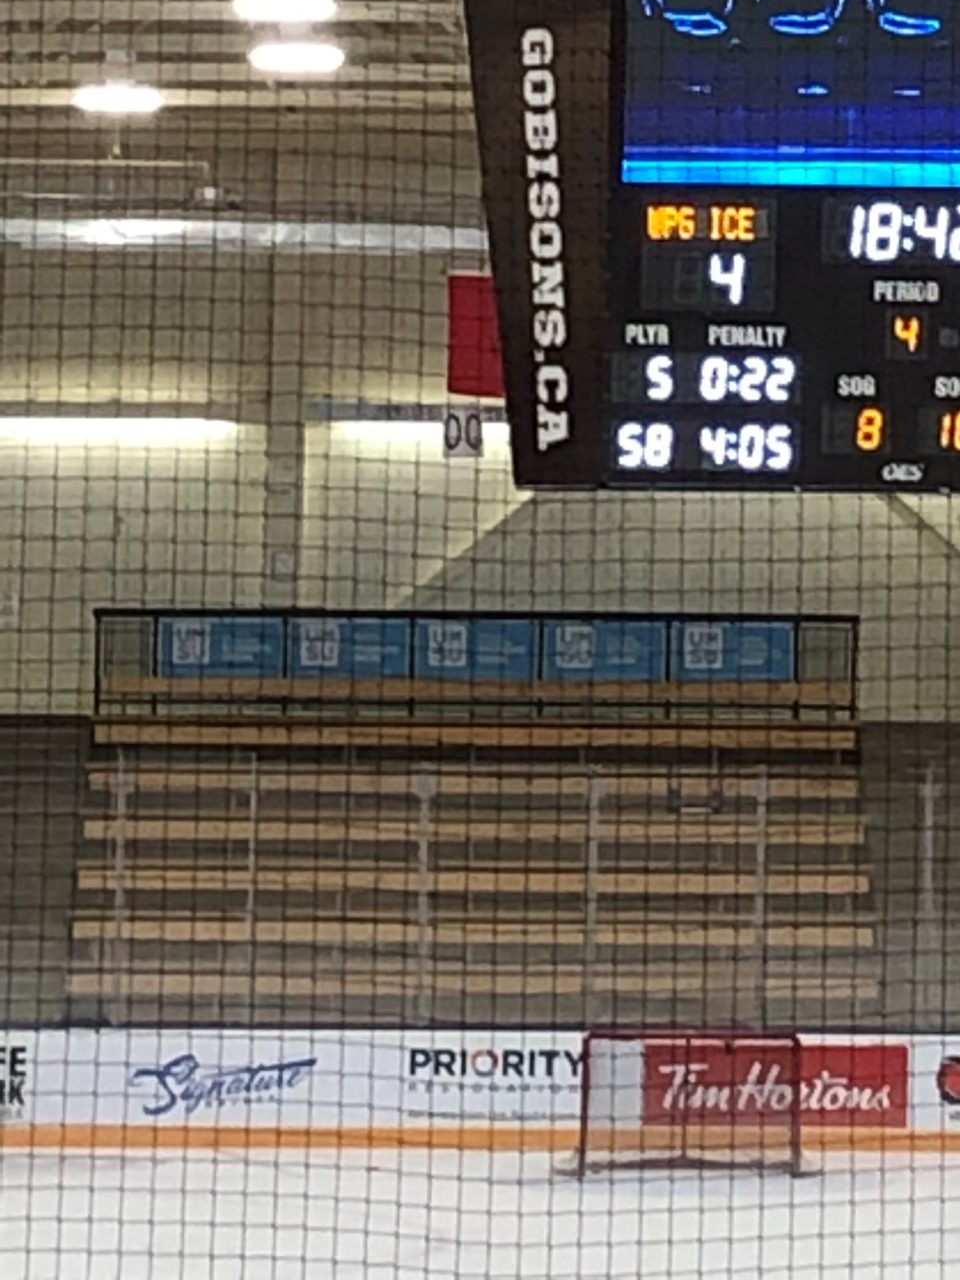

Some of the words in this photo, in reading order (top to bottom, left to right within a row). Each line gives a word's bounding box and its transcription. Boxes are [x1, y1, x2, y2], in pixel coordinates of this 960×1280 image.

[521, 28, 571, 452] GOBISONS.CA
[710, 206, 755, 240] ICE
[708, 252, 746, 305] 4
[873, 280, 940, 302] PERIOD
[625, 324, 670, 345] PLYR
[707, 325, 787, 348] PENALTY
[894, 316, 920, 352] 4
[699, 356, 796, 402] 0:22
[837, 374, 876, 396] SOG
[699, 424, 793, 470] 4:05
[856, 408, 883, 450] 8
[127, 1053, 318, 1115] Signature
[410, 1049, 583, 1077] PRIORITY
[658, 1064, 730, 1111] Tim
[737, 1061, 891, 1111] Hortons
